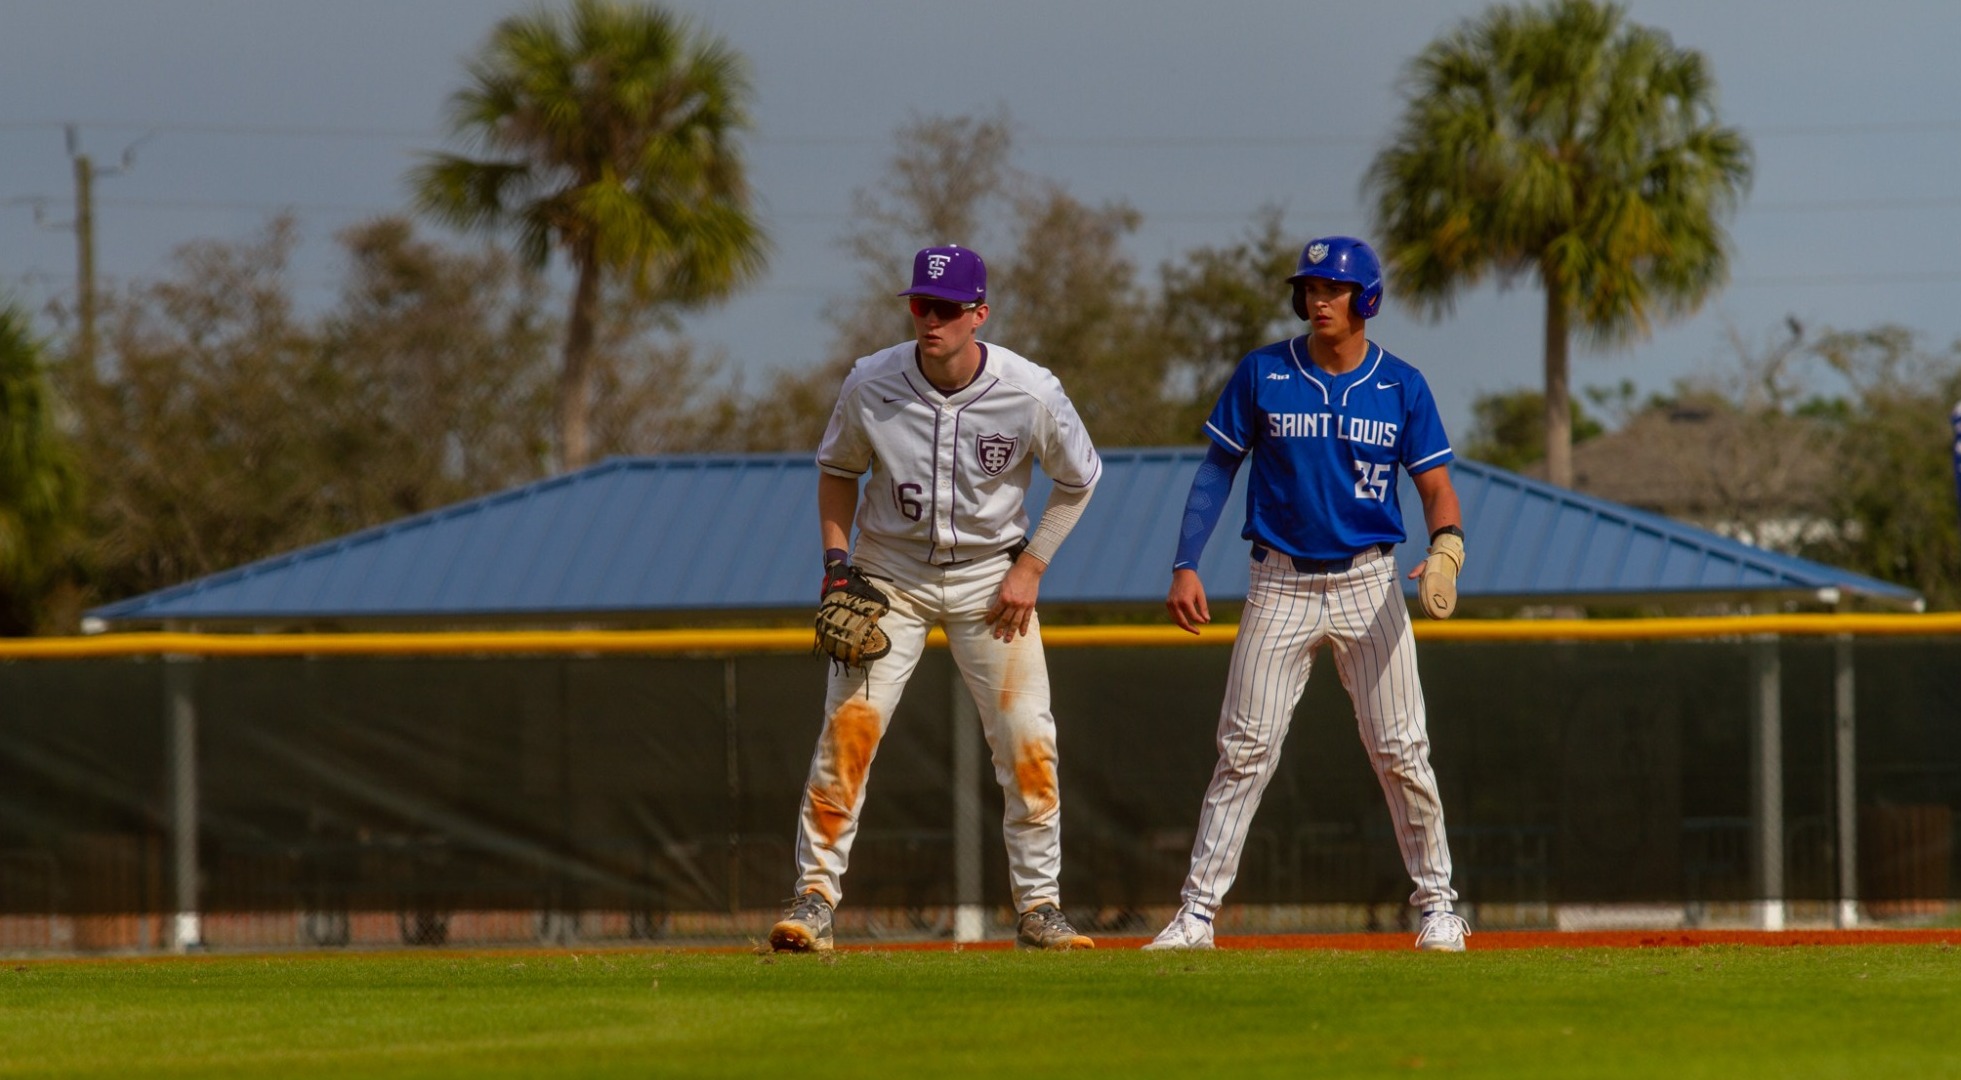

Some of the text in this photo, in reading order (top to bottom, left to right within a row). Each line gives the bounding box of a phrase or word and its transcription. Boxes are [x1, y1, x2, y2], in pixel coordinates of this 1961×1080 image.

[1268, 413, 1397, 448] SAINT LOUIS
[1354, 460, 1390, 503] 25
